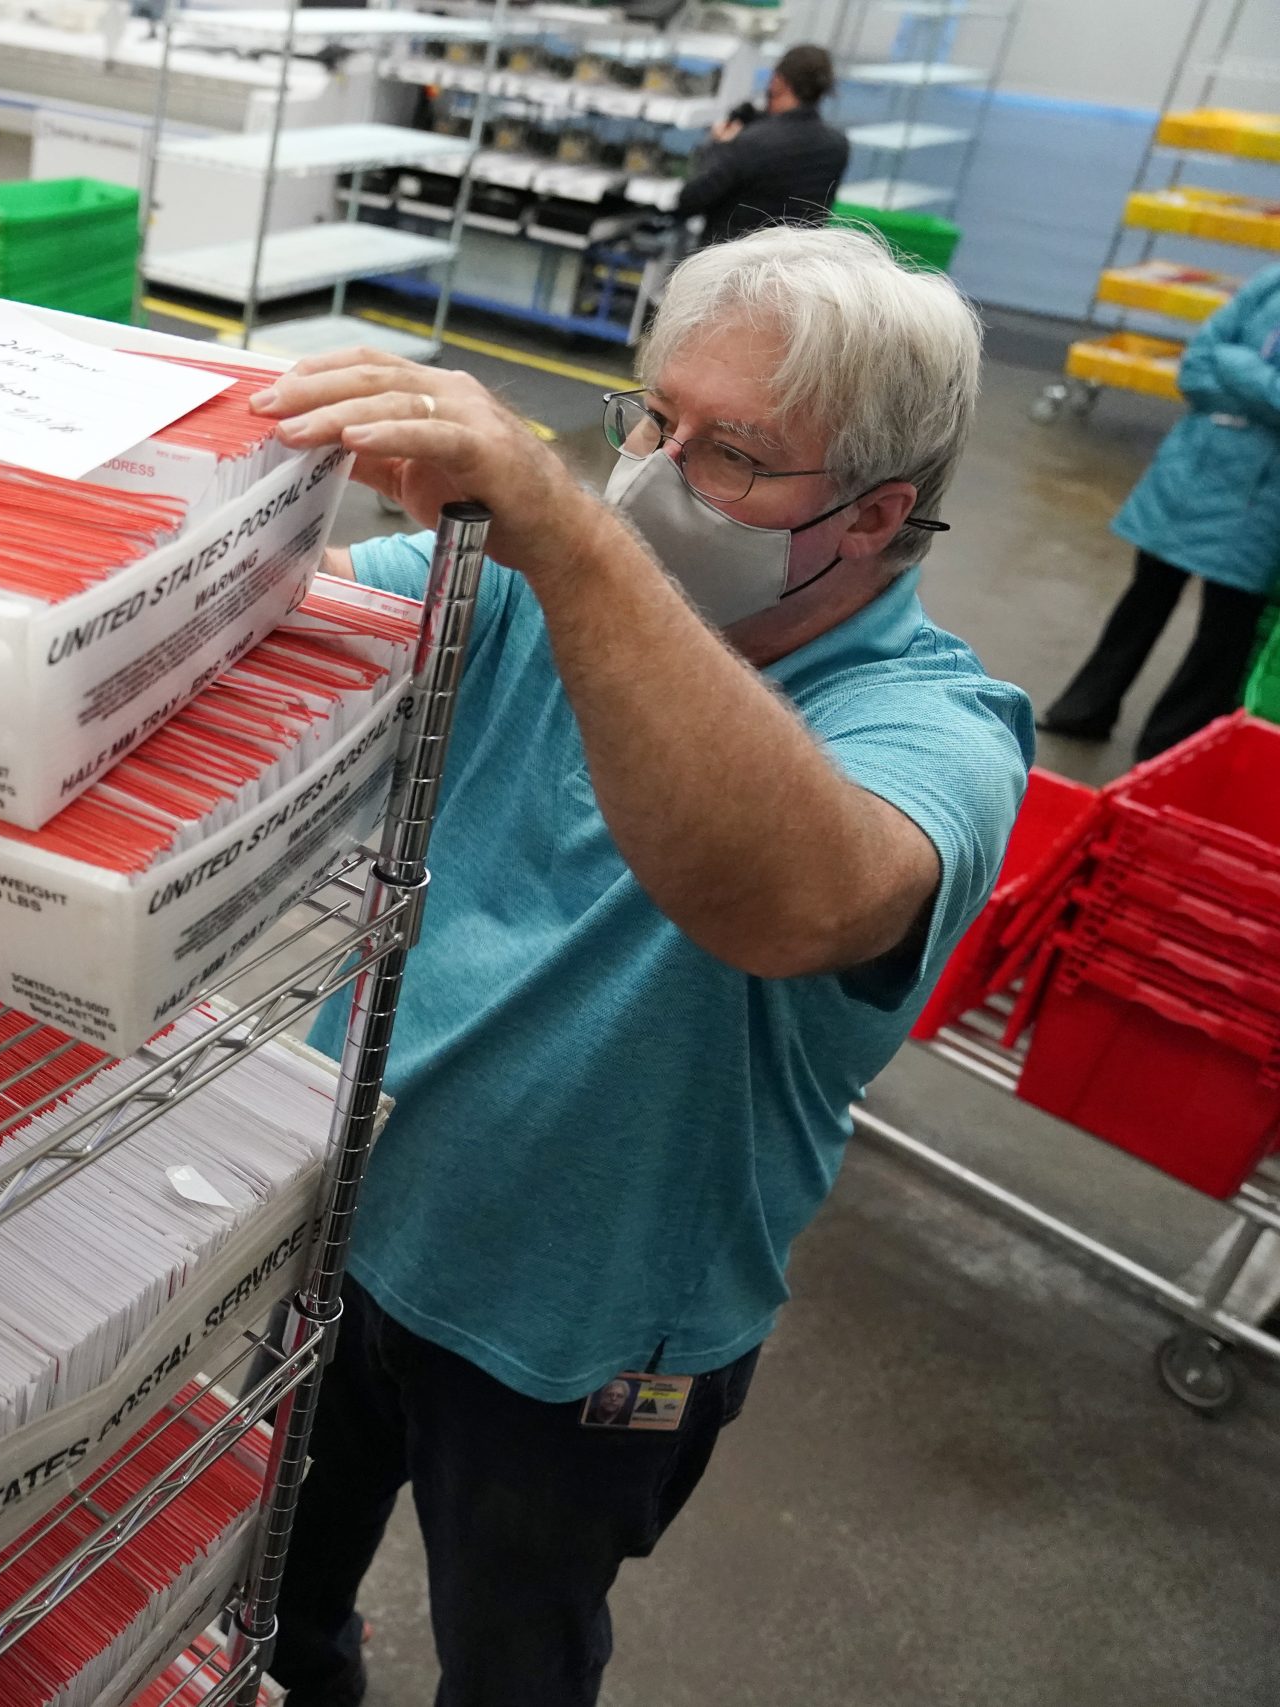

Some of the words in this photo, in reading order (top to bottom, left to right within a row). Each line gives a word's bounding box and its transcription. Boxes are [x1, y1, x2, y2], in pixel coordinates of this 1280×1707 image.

[47, 590, 146, 667] UNITED
[149, 530, 234, 607] STATES
[233, 477, 304, 549] POSTAL
[194, 548, 259, 611] WARNING
[60, 750, 107, 797] HALF
[148, 840, 243, 915] UNITED
[246, 773, 328, 852] STATES
[327, 713, 391, 787] POSTAL
[7, 891, 42, 912] LBS
[202, 1222, 307, 1337] SERVICE
